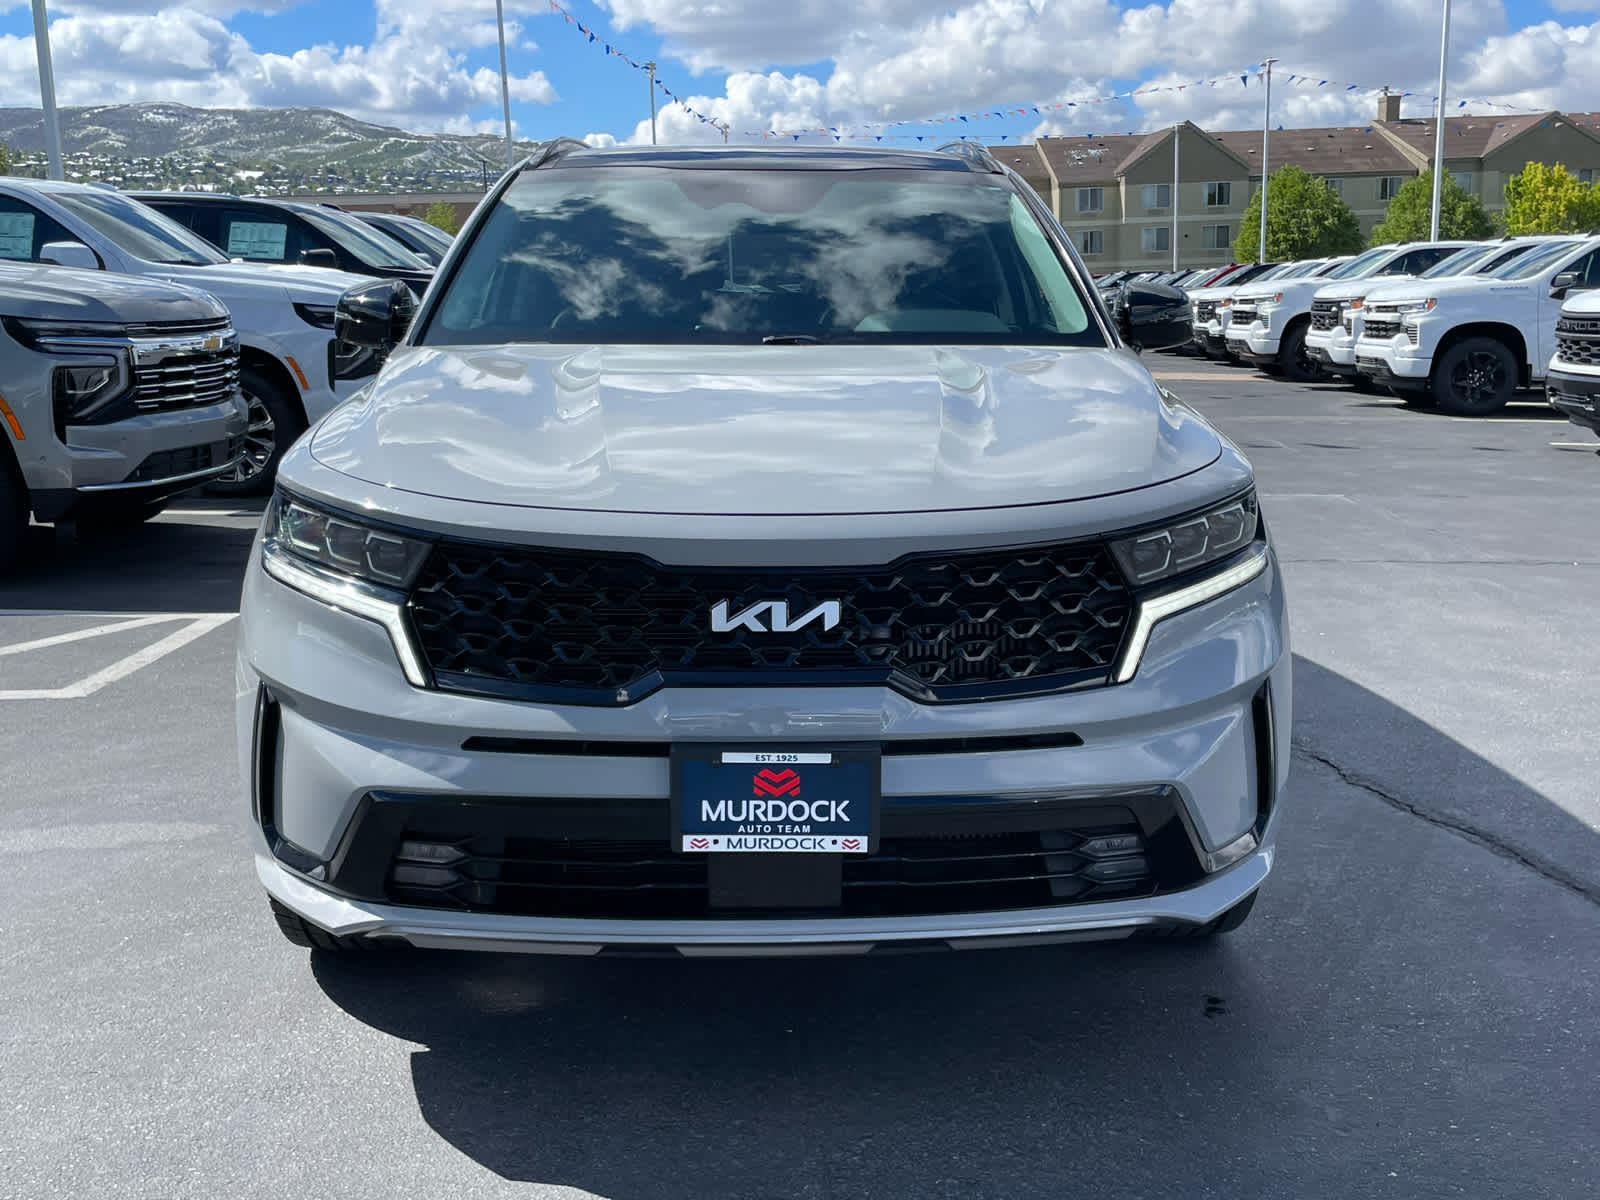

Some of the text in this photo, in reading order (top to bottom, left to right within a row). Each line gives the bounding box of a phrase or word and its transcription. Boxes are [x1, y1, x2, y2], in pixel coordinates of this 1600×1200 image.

[711, 599, 841, 632] KIA
[755, 754, 799, 762] EST. 1925
[701, 799, 850, 822] MURDOCK
[738, 825, 811, 833] AUTO TEAM
[726, 837, 826, 850] MURDOCK
